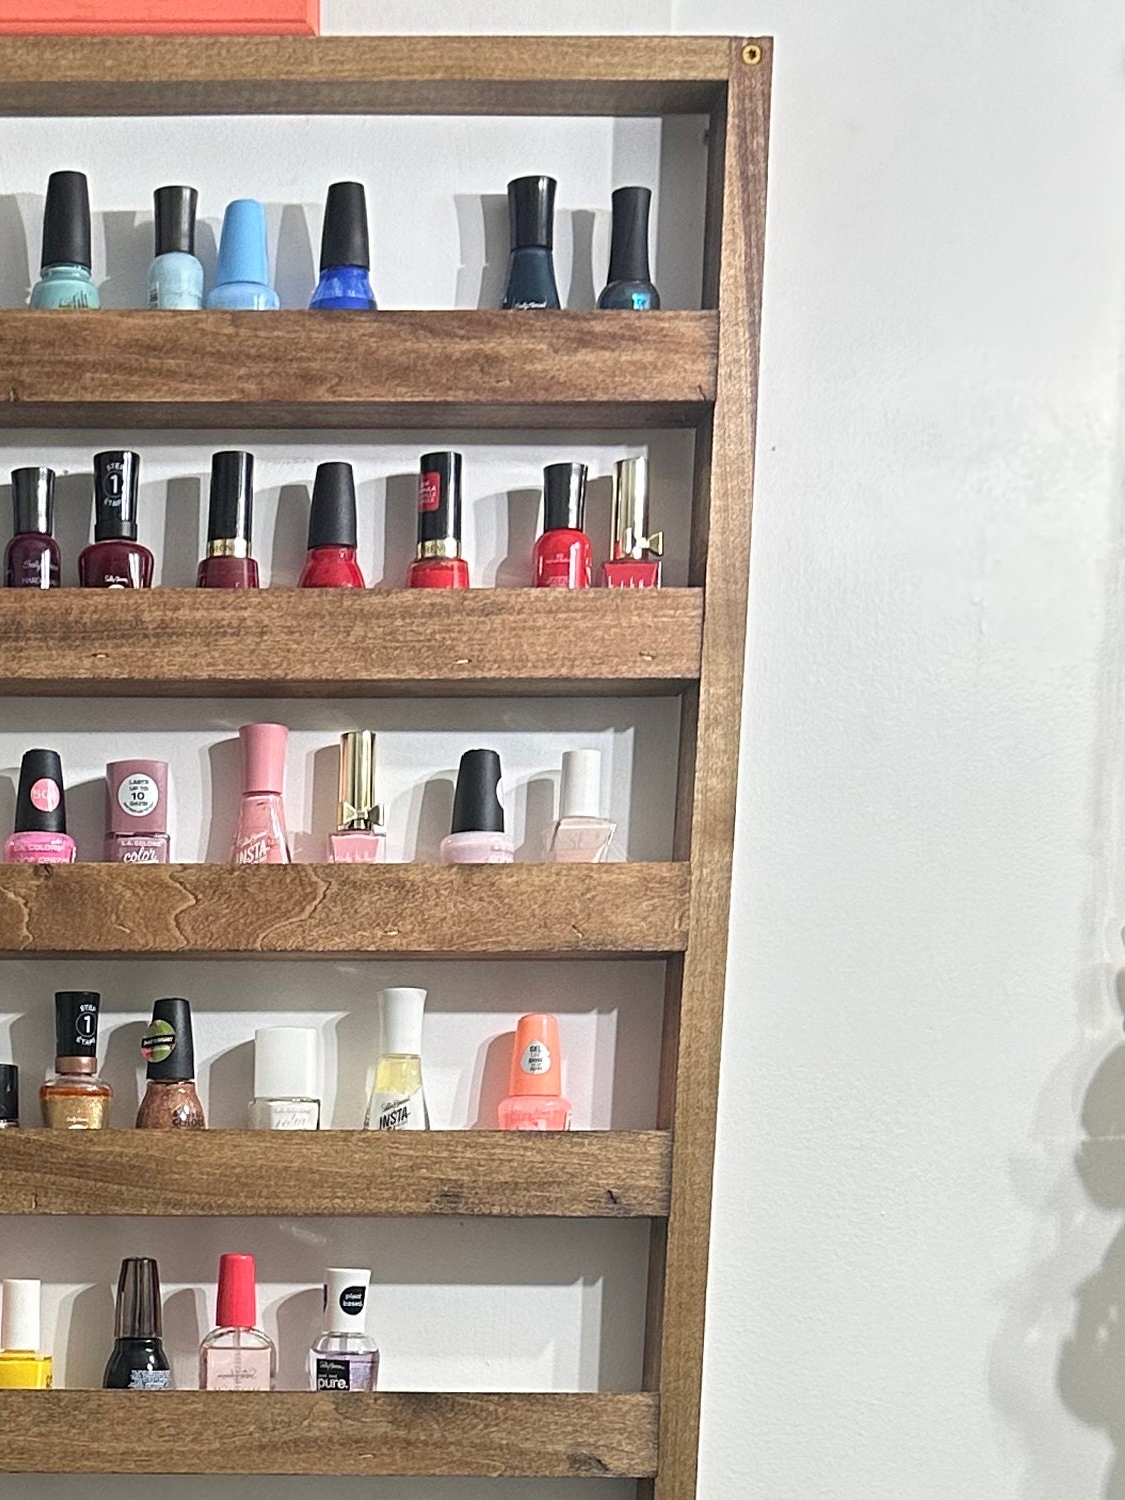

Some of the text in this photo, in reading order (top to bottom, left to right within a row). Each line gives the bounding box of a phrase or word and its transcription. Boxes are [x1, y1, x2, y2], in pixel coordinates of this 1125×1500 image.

[109, 474, 119, 495] 1
[131, 792, 145, 801] 10
[123, 844, 157, 864] color
[83, 1015, 91, 1034] 1
[317, 1378, 350, 1391] pure.
